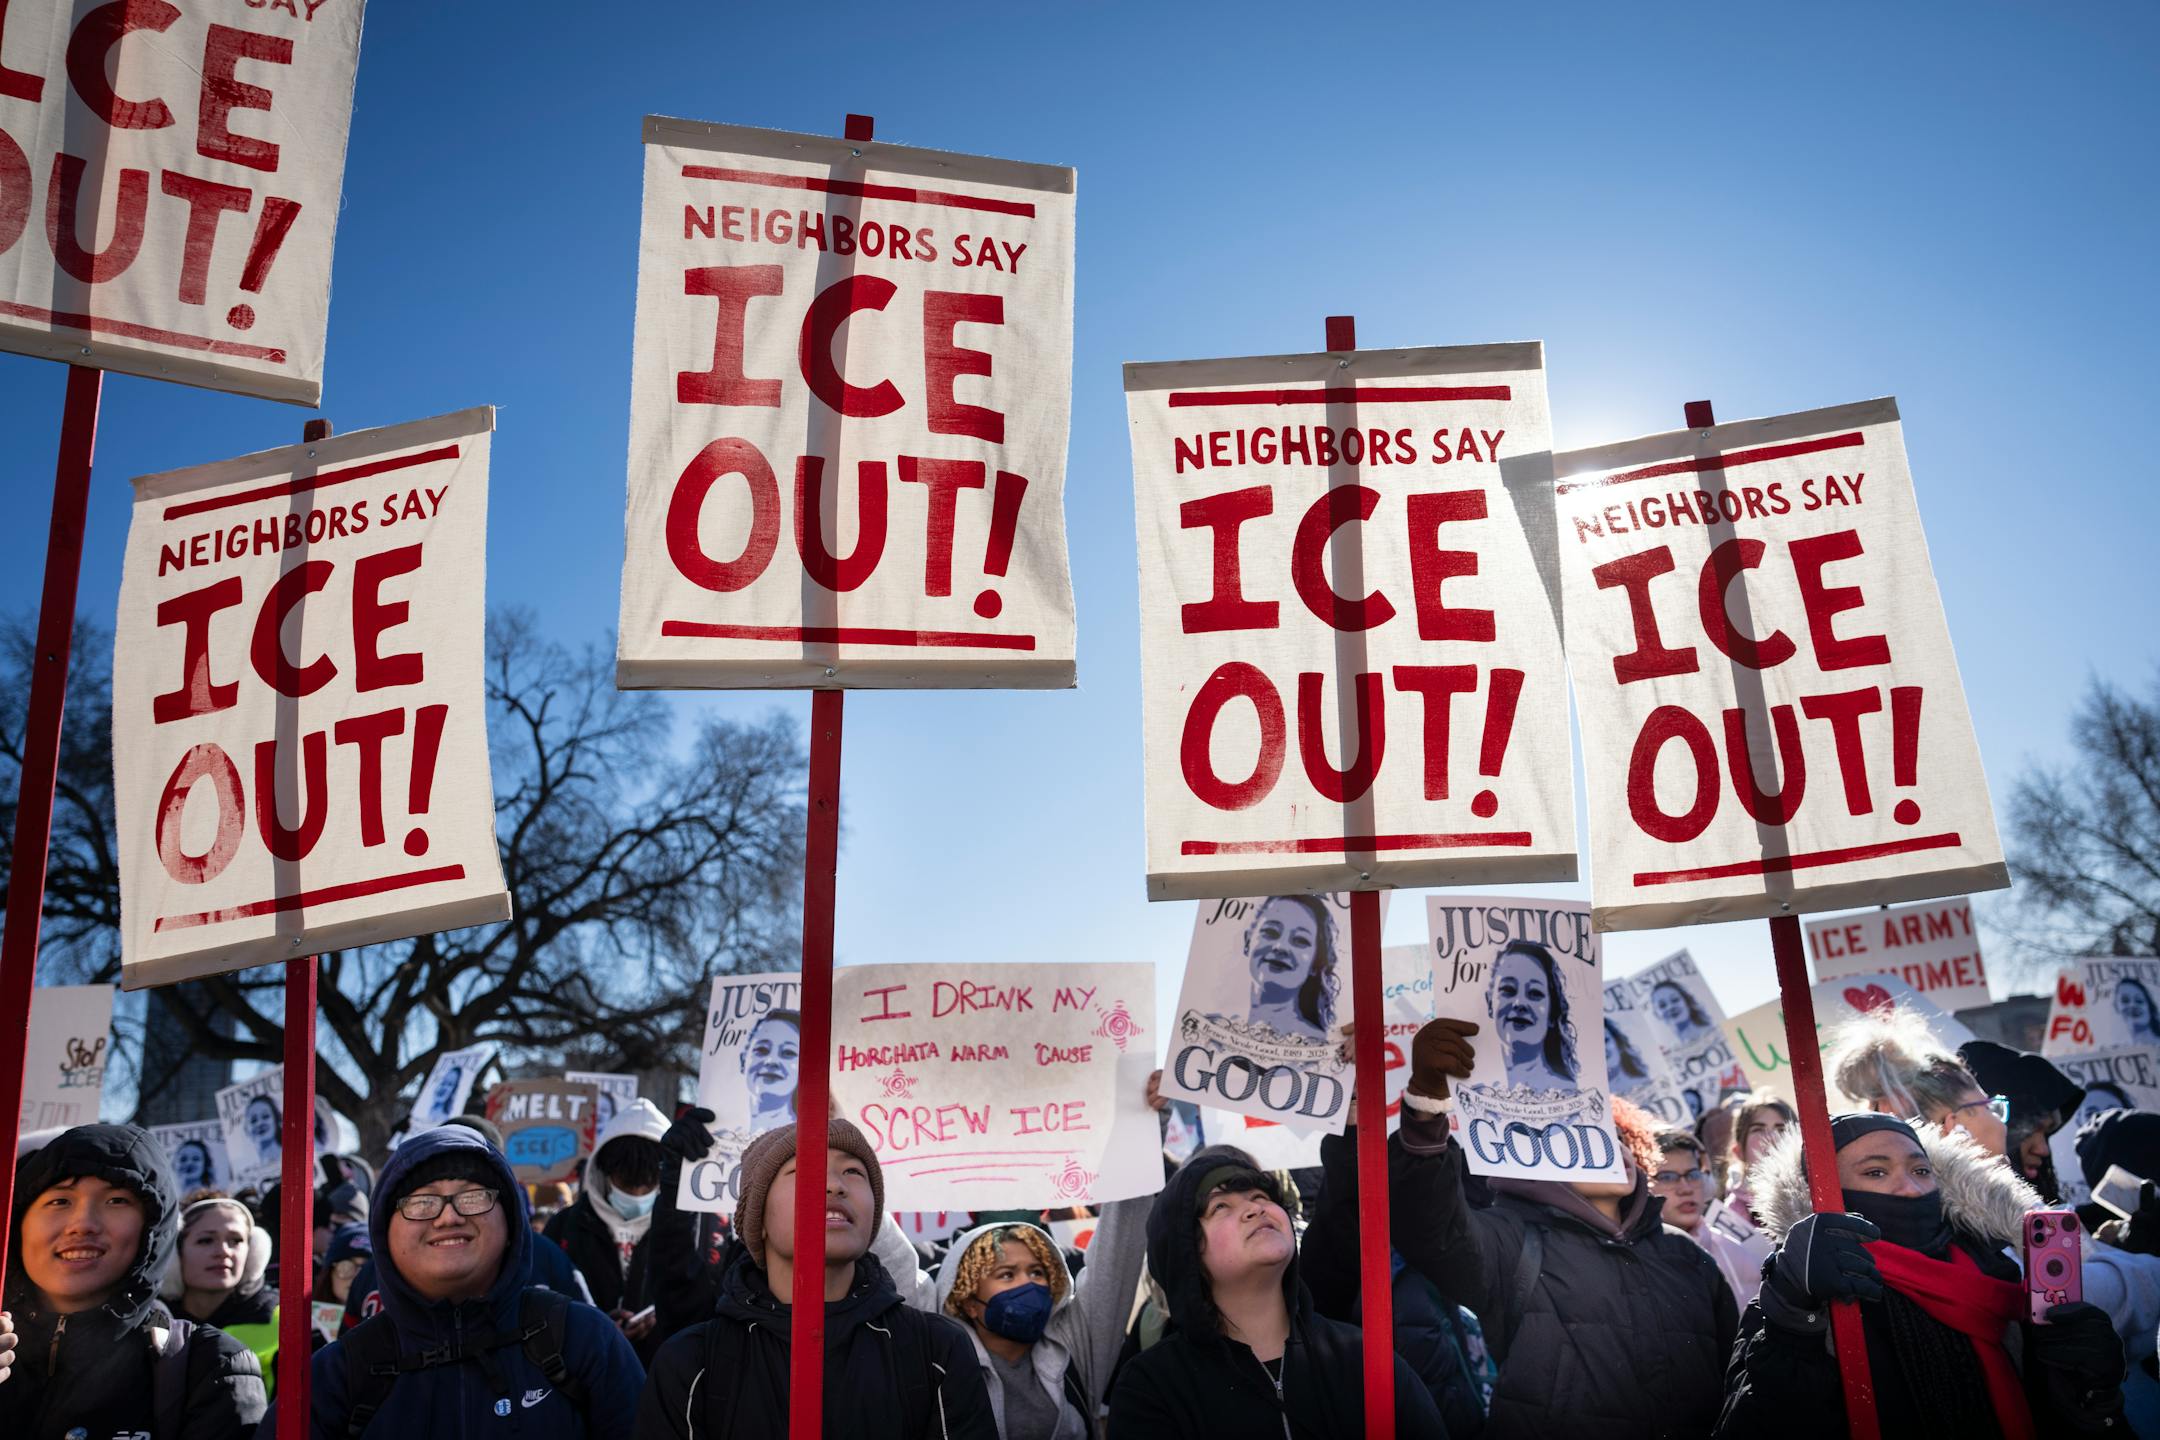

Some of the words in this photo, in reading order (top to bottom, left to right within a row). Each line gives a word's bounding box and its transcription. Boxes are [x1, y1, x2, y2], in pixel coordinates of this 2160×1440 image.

[684, 204, 938, 263] NEIGHBORS
[952, 234, 1027, 275] SAY
[677, 264, 1005, 444] ICE
[1174, 425, 1418, 474] NEIGHBORS
[1432, 428, 1506, 465] SAY
[158, 500, 369, 577] NEIGHBORS
[380, 485, 449, 527] SAY
[666, 437, 1029, 619] OUT!
[1572, 482, 1791, 544] NEIGHBORS
[1801, 473, 1865, 512] SAY
[1180, 484, 1497, 642] ICE
[153, 542, 424, 724] ICE
[1592, 528, 1892, 685] ICE
[1180, 661, 1526, 819] OUT!
[1627, 685, 1924, 843] OUT!
[155, 704, 449, 885] OUT!
[1437, 906, 1596, 967] JUSTICE
[1809, 924, 1868, 961] ICE
[1884, 905, 1972, 949] ARMY
[1444, 948, 1487, 994] for
[1629, 954, 1698, 997] USTICE
[1878, 952, 1987, 992] OME!
[713, 982, 802, 1029] JUST
[861, 984, 911, 1022] I
[932, 980, 1034, 1018] DRINK
[1052, 986, 1097, 1013] MY
[710, 1019, 747, 1056] for
[838, 1042, 940, 1072] HORCHATA
[951, 1044, 1010, 1062] WARM
[1034, 1042, 1094, 1066] 'CAUSE
[1174, 1045, 1344, 1119] GOOD
[2062, 1053, 2158, 1090] STICE
[502, 1093, 588, 1122] MELT
[860, 1103, 991, 1152] SCREW
[1010, 1101, 1091, 1135] ICE
[1469, 1118, 1615, 1170] GOOD
[525, 1388, 543, 1400] NIKE
